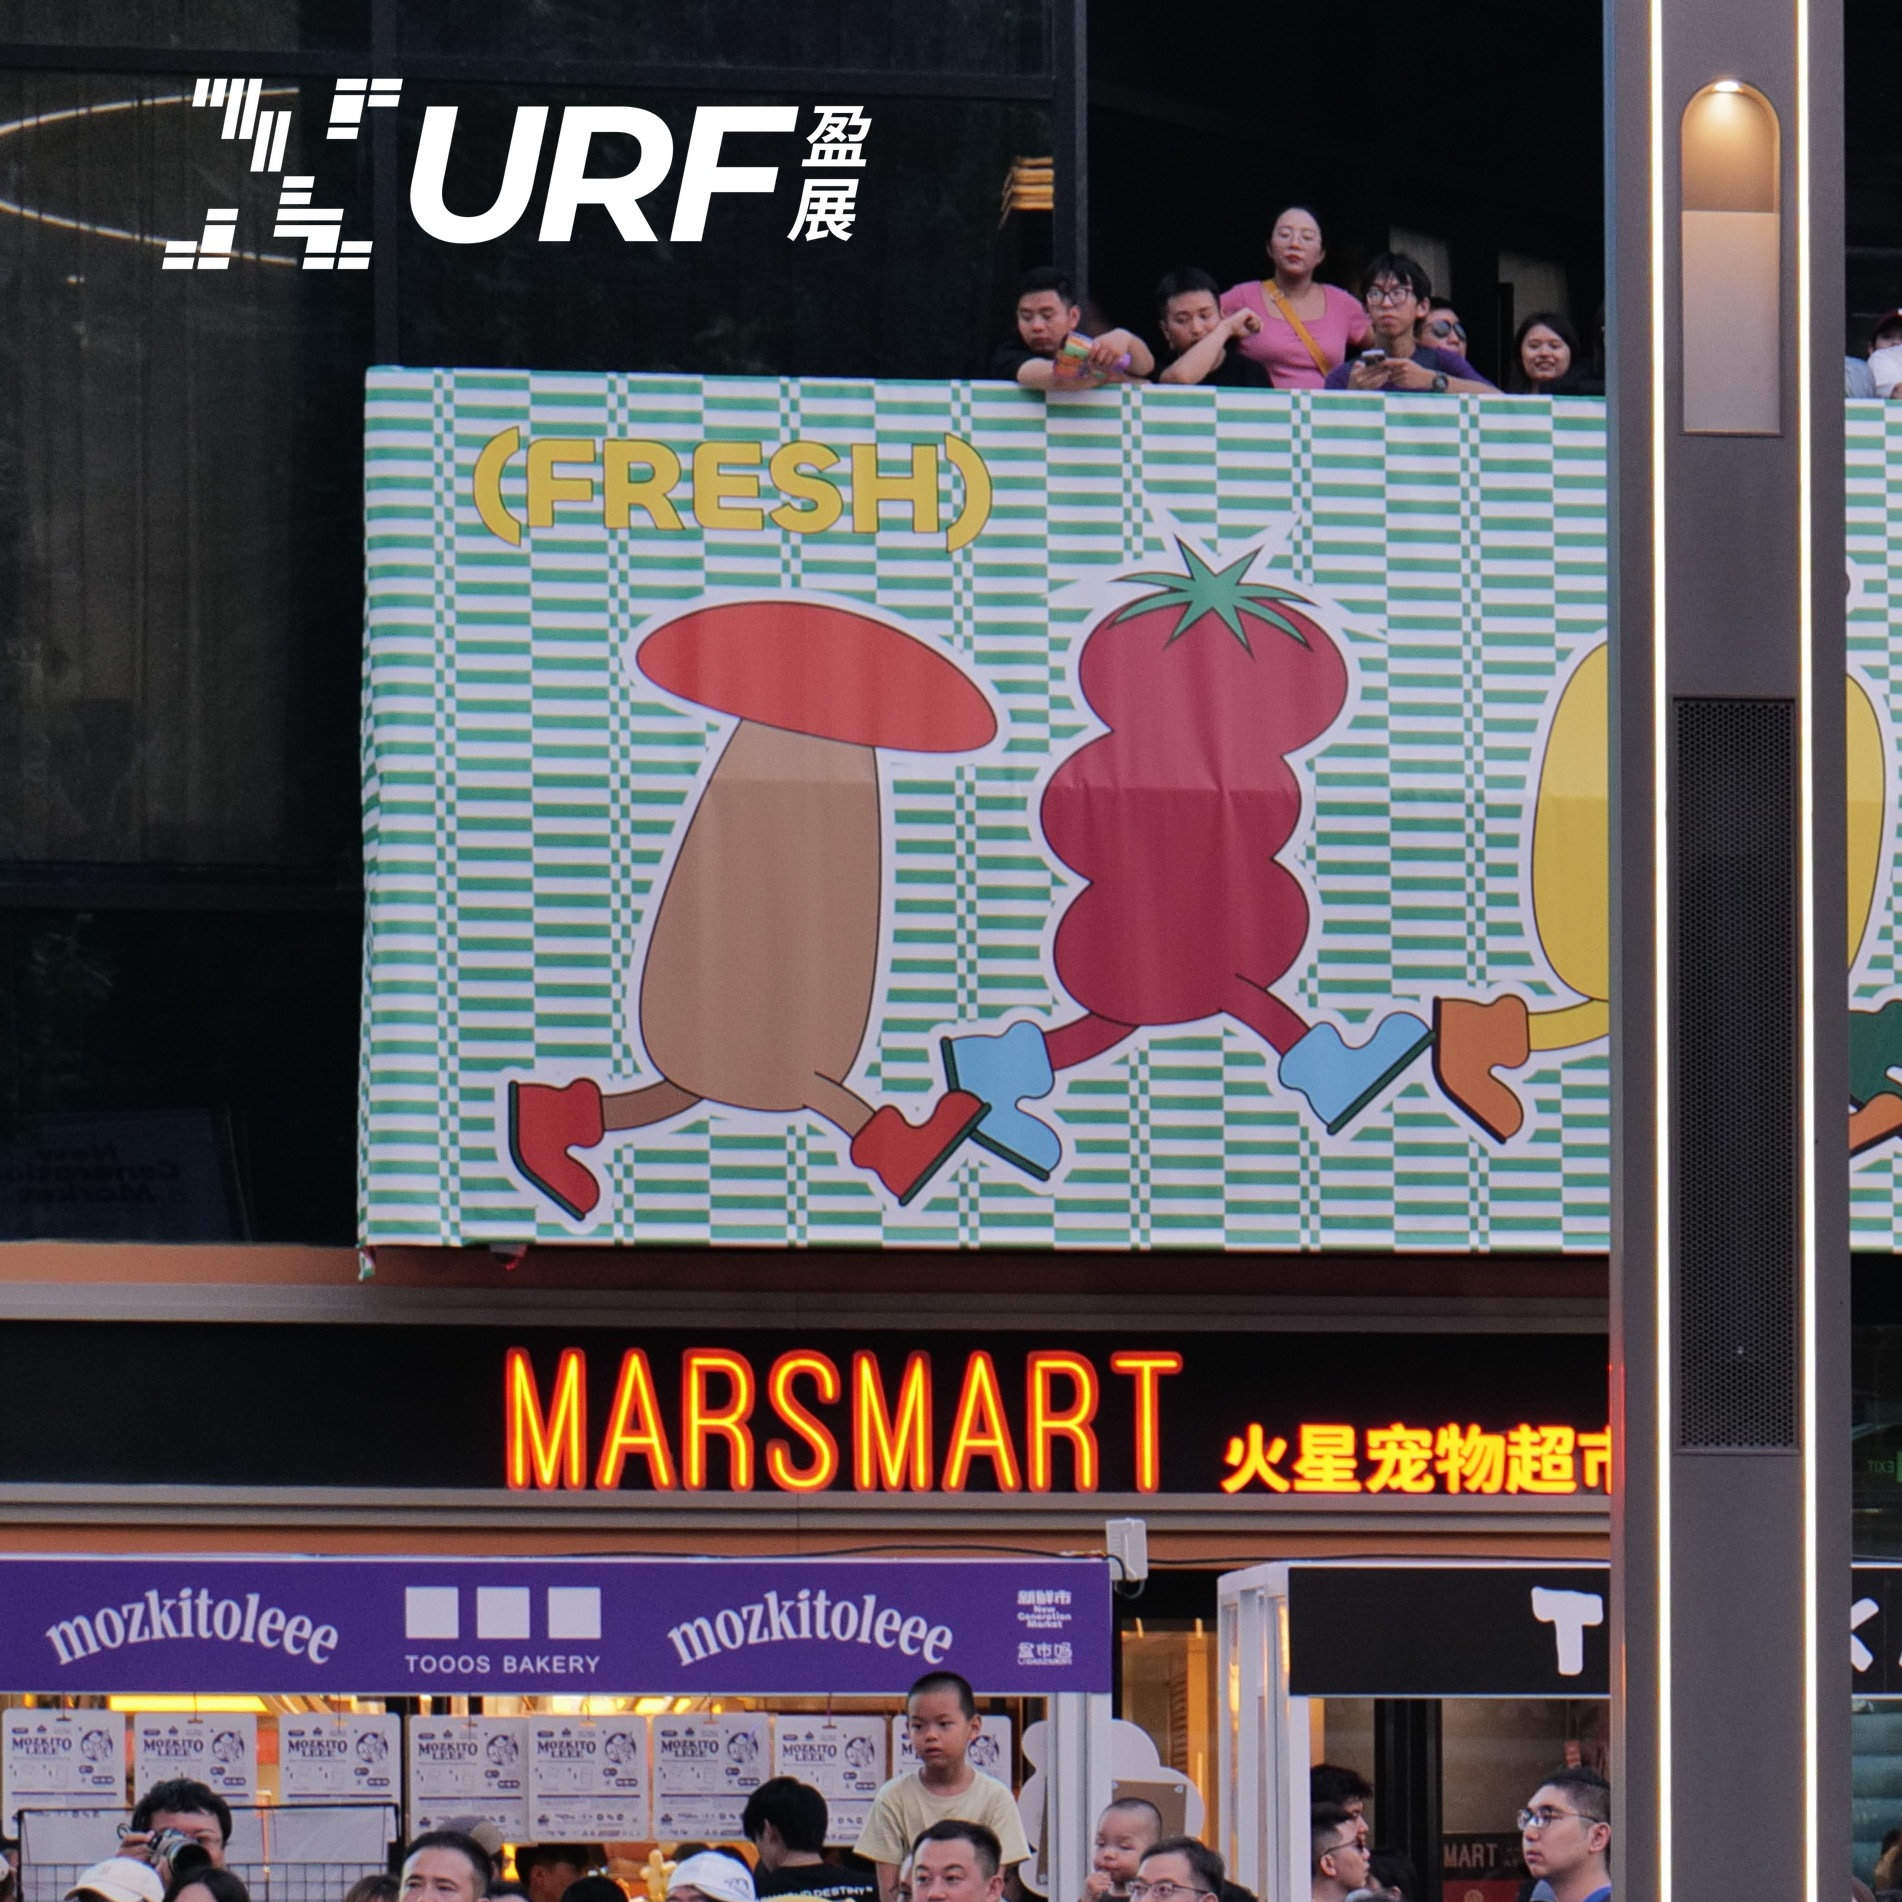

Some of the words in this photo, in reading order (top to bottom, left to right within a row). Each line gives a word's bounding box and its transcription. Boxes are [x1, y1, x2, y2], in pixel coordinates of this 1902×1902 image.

[472, 426, 993, 554] (FRESH)
[505, 1348, 1183, 1493] MARSMART
[45, 1586, 339, 1667] mozkitoleee
[405, 1655, 492, 1674] TOOOS
[502, 1655, 600, 1674] BAKERY
[667, 1588, 954, 1669] mozkitoleee
